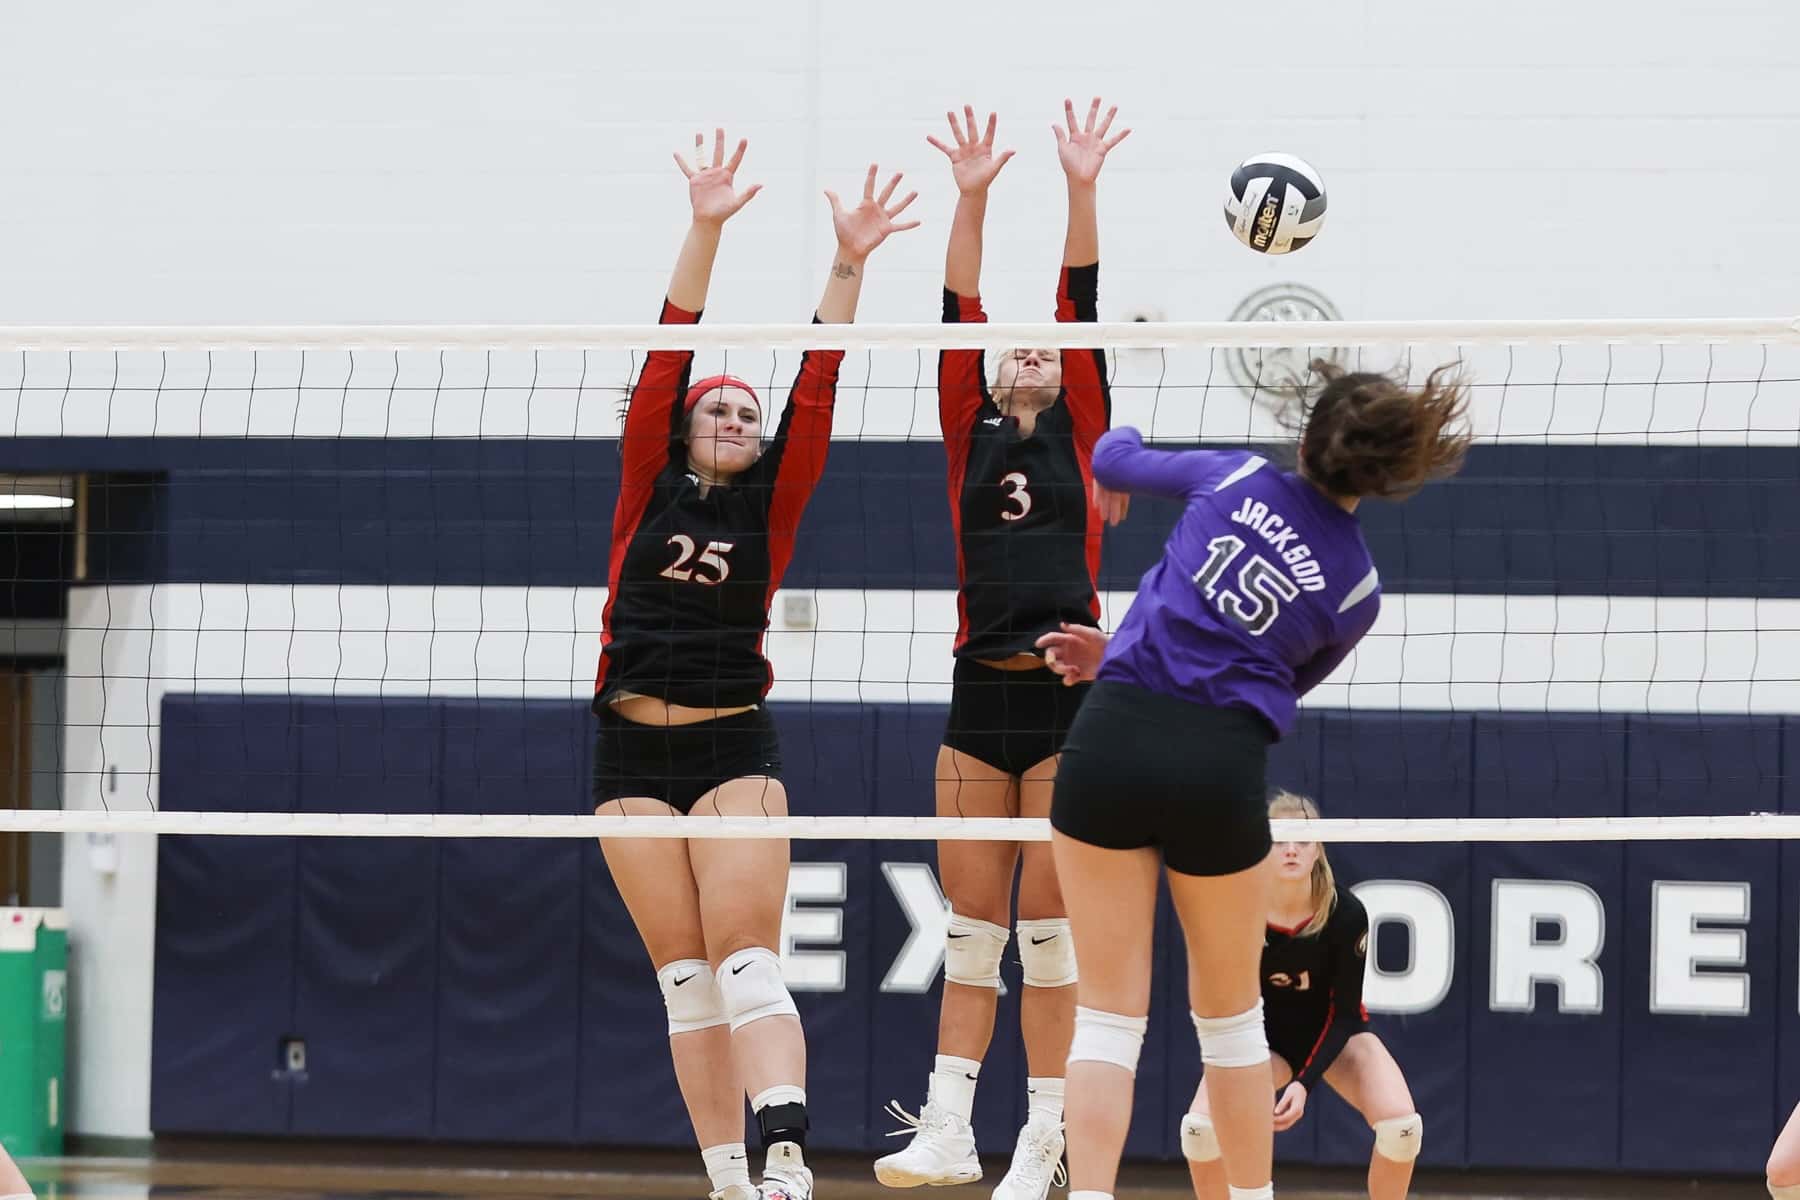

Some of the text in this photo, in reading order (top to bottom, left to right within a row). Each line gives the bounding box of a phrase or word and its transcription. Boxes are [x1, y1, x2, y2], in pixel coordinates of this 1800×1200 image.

[1253, 193, 1280, 248] molten
[999, 472, 1032, 521] 3
[658, 533, 735, 586] 25
[1230, 497, 1327, 592] JACKSON
[1192, 534, 1300, 636] 15
